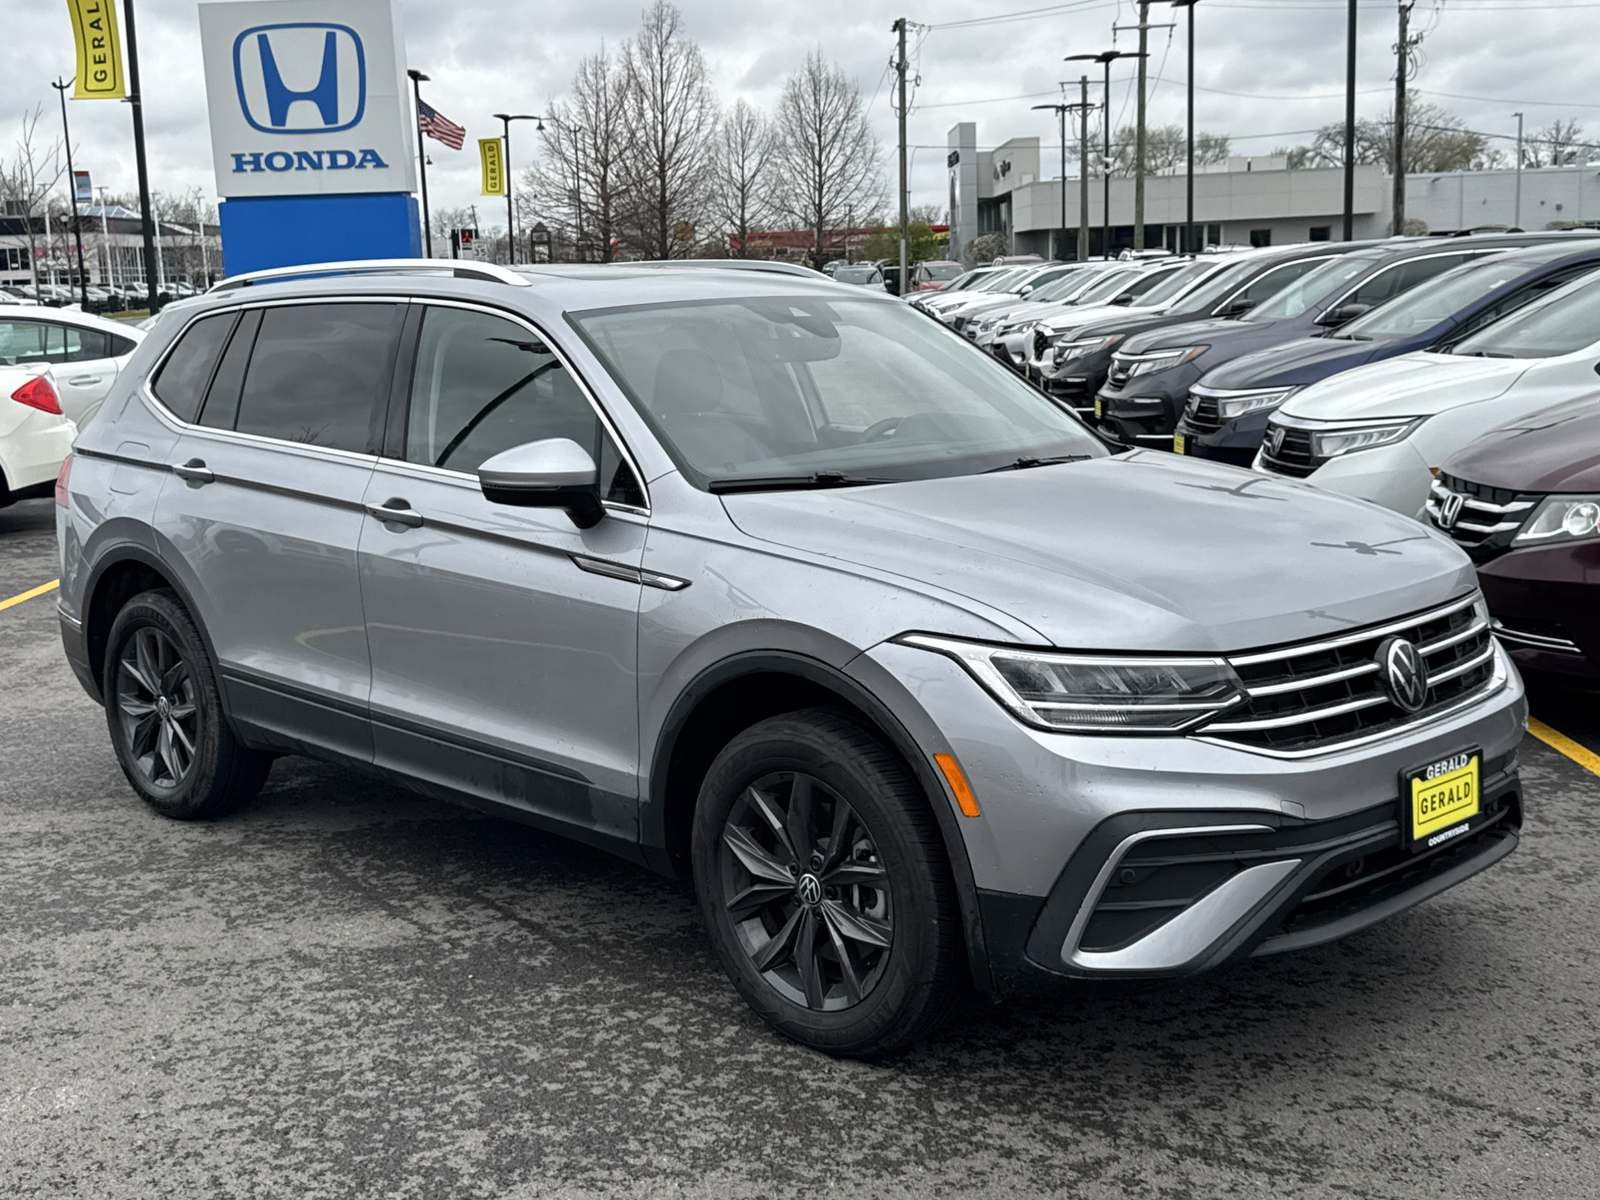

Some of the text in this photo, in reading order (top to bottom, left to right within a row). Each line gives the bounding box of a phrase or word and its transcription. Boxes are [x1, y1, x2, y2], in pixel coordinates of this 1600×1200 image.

[230, 148, 390, 173] HONDA
[487, 144, 498, 189] GERALD
[474, 248, 487, 257] 35
[1426, 753, 1468, 780] GERALD
[1420, 781, 1471, 815] GERALD
